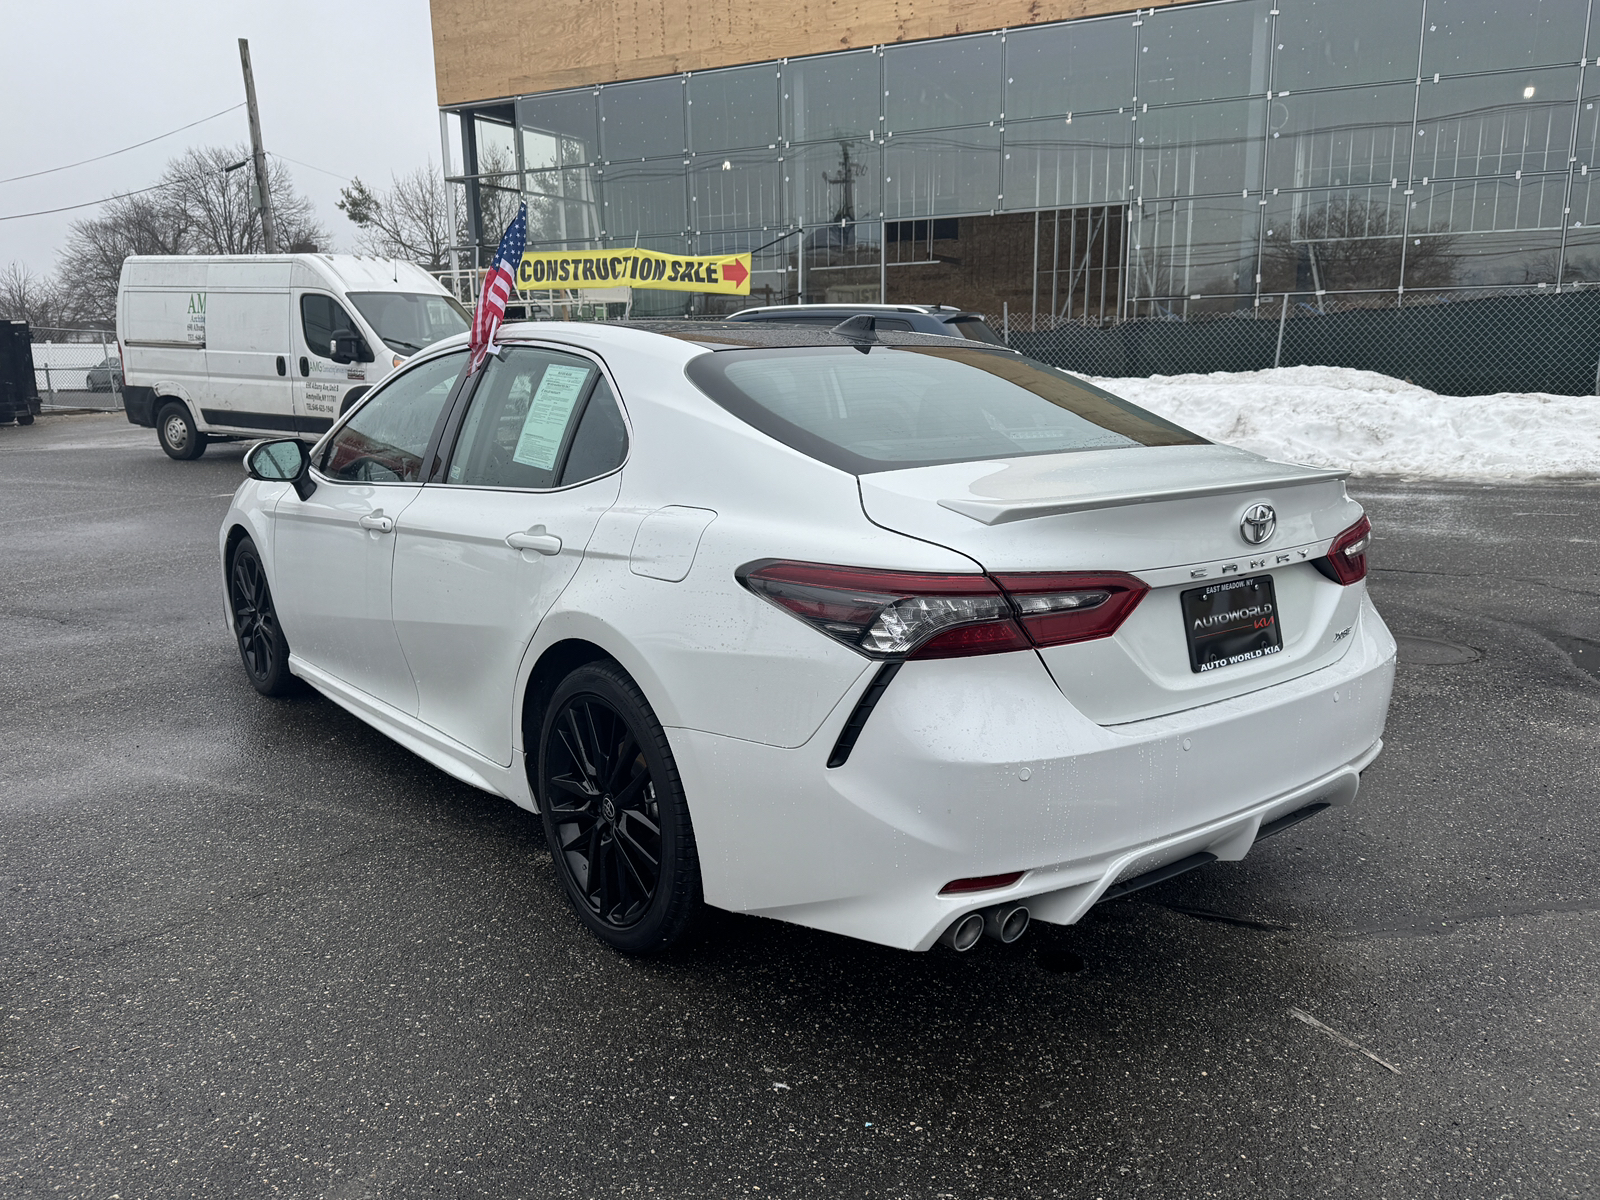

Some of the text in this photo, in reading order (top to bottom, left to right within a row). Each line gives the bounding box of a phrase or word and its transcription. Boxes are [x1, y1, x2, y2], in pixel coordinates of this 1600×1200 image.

[520, 257, 719, 284] CONSTRUCTION SALE
[309, 361, 323, 373] AMG
[1190, 549, 1309, 579] CAMRY
[1206, 585, 1220, 594] EAST
[1193, 603, 1273, 631] AUTOWORLD
[1253, 616, 1275, 629] KIA
[1200, 645, 1281, 672] AUTO WORLD KIA
